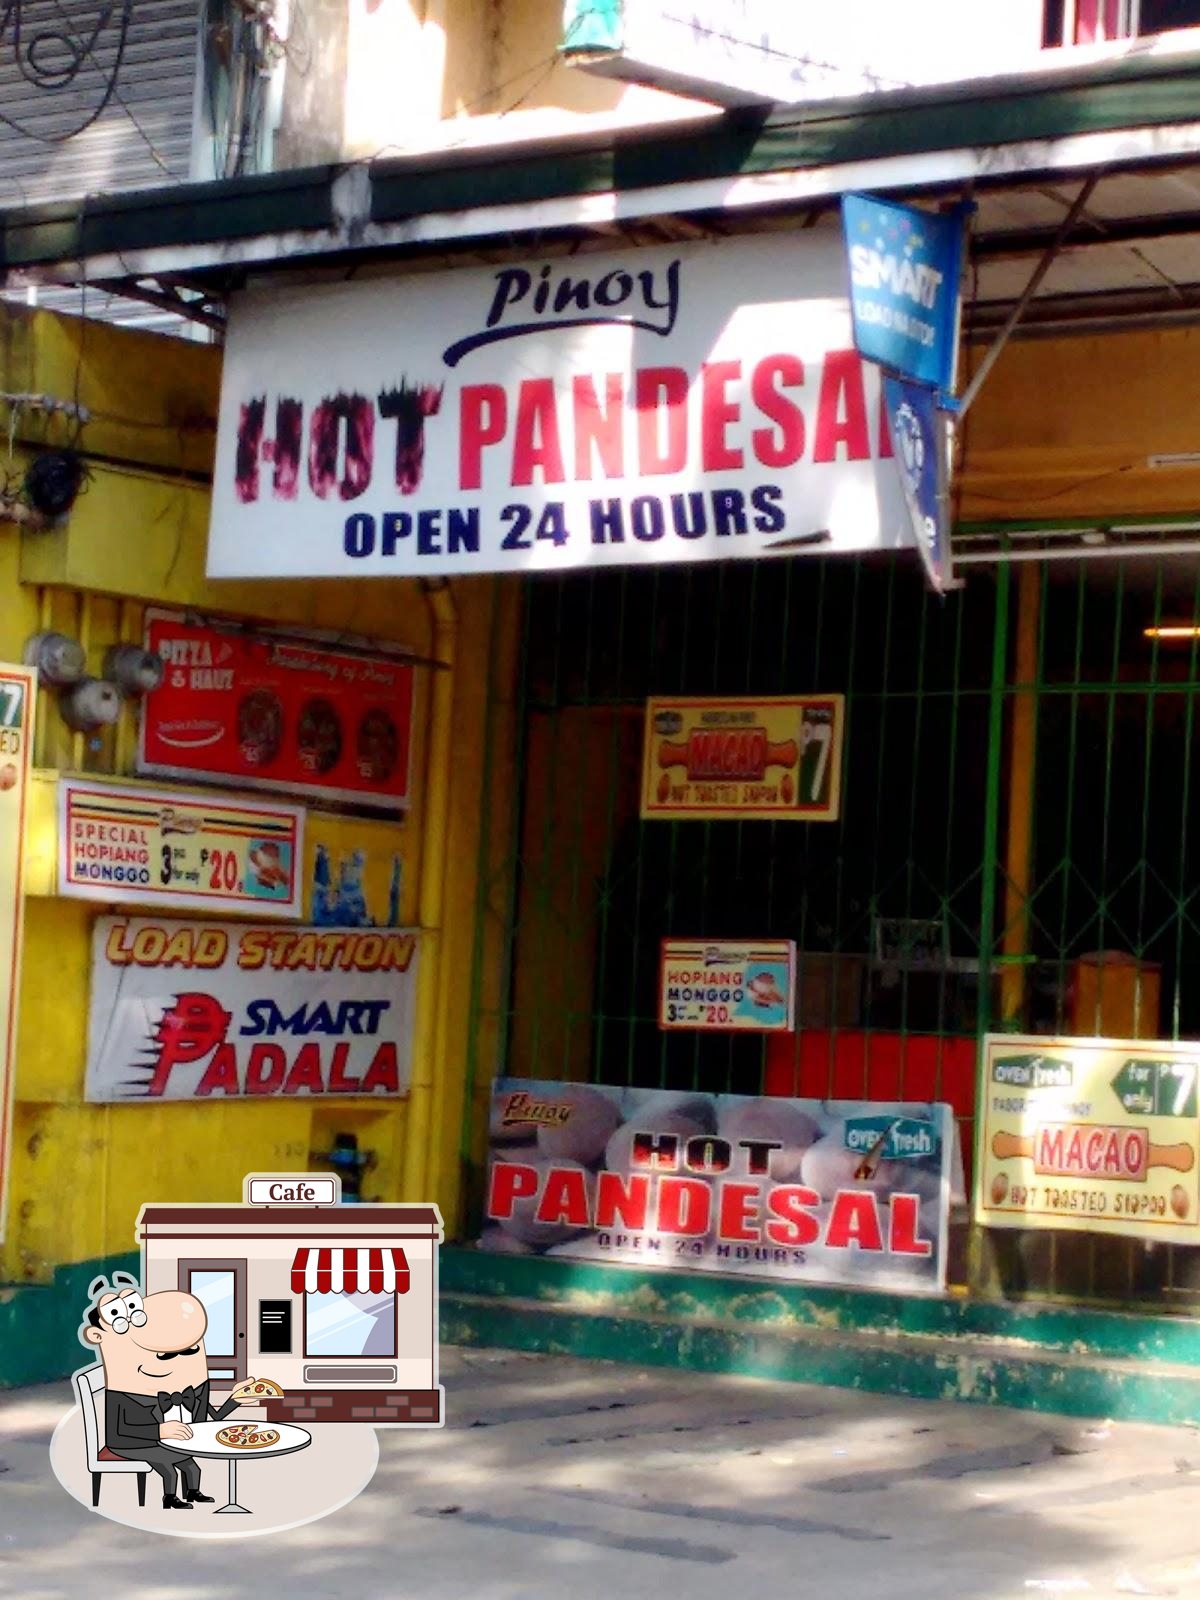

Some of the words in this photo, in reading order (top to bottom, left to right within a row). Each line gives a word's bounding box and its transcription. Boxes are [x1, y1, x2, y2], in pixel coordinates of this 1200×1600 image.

[486, 260, 681, 336] Pinoy
[234, 376, 445, 504] HOT
[344, 506, 480, 558] OPEN
[500, 502, 569, 551] 24
[590, 484, 787, 546] HOURS
[75, 823, 149, 846] SPECIAL
[75, 843, 150, 864] HOPIANG
[75, 862, 150, 884] MONGGO
[161, 844, 172, 885] 3
[106, 925, 228, 968] LOAD
[237, 931, 417, 973] STATION
[668, 971, 743, 985] HOPIANG
[668, 988, 744, 1003] MONGGO
[240, 999, 390, 1036] SMART
[147, 992, 400, 1097] PADALA
[632, 1132, 784, 1175] HOT
[1040, 1127, 1144, 1175] MACAO
[488, 1162, 932, 1257] PANDESAL
[599, 1233, 661, 1251] OPEN
[717, 1244, 808, 1265] HOURS
